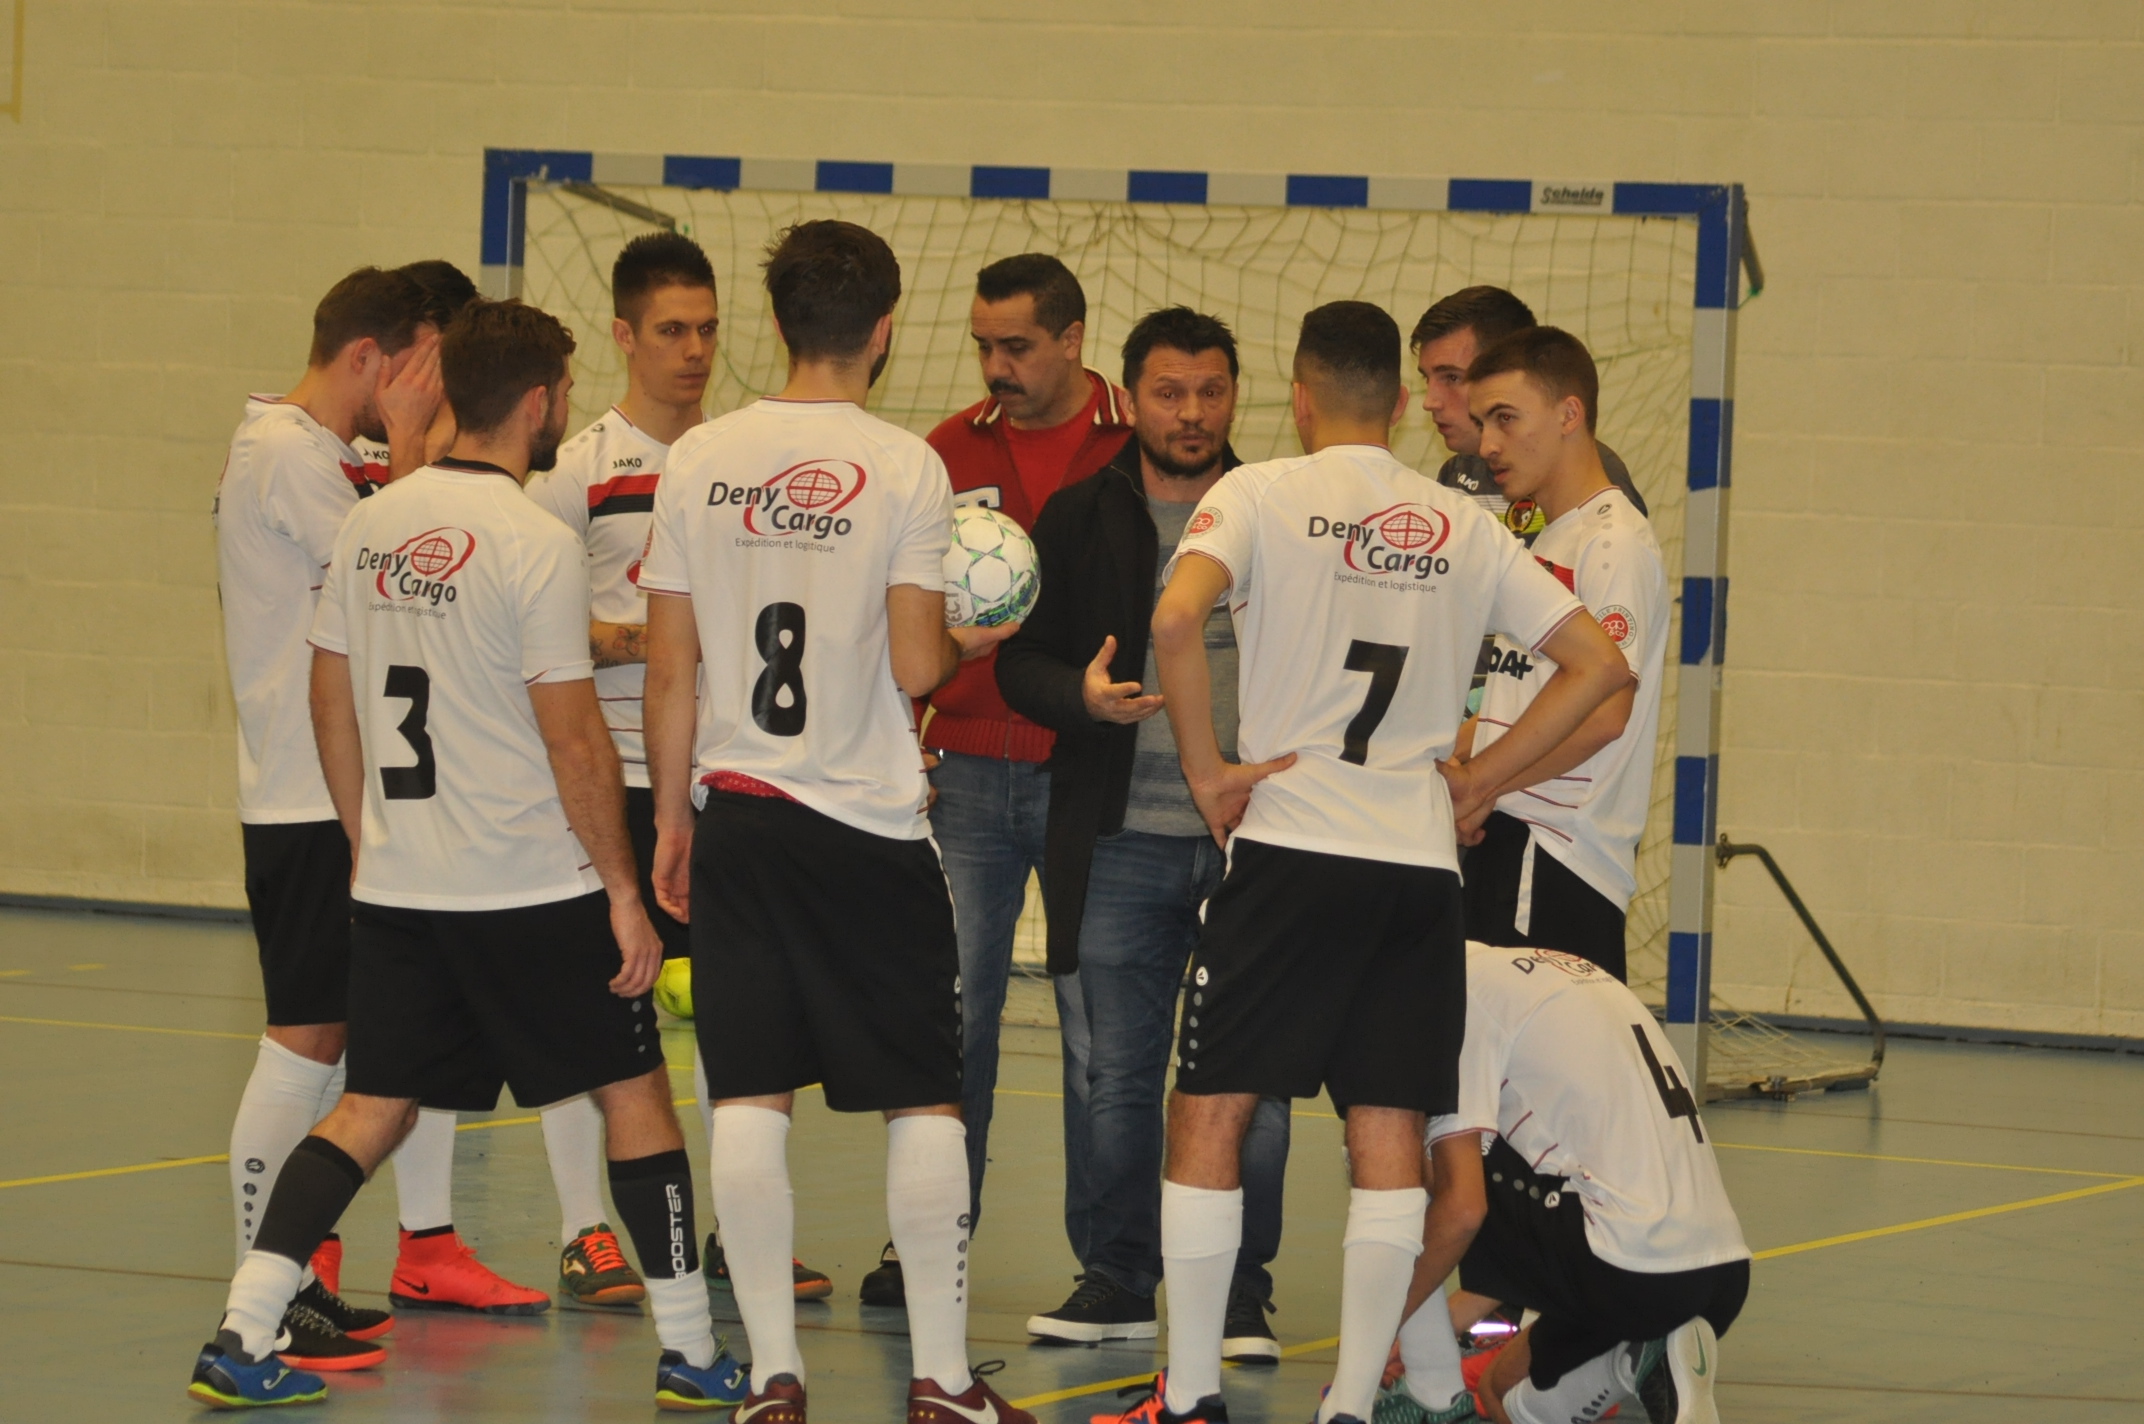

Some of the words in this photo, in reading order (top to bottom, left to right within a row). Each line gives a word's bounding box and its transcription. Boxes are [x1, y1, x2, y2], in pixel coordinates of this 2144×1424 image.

[363, 448, 389, 460] JKO
[612, 457, 642, 469] JAKO
[707, 482, 782, 512] Deny
[1457, 472, 1479, 491] AKO
[771, 505, 853, 540] Cargo
[1307, 516, 1375, 550] Deny
[735, 538, 782, 549] Expédition
[784, 539, 793, 549] et
[795, 540, 836, 553] logitique
[356, 547, 409, 578] Deny
[1367, 546, 1450, 580] Cargo
[399, 571, 457, 606] Cargo
[1378, 579, 1388, 588] et
[1390, 580, 1437, 593] logistique
[751, 601, 807, 737] 8
[1339, 638, 1410, 766] 7
[379, 664, 437, 800] 3
[1564, 962, 1598, 975] Car
[1630, 1023, 1704, 1144] 4
